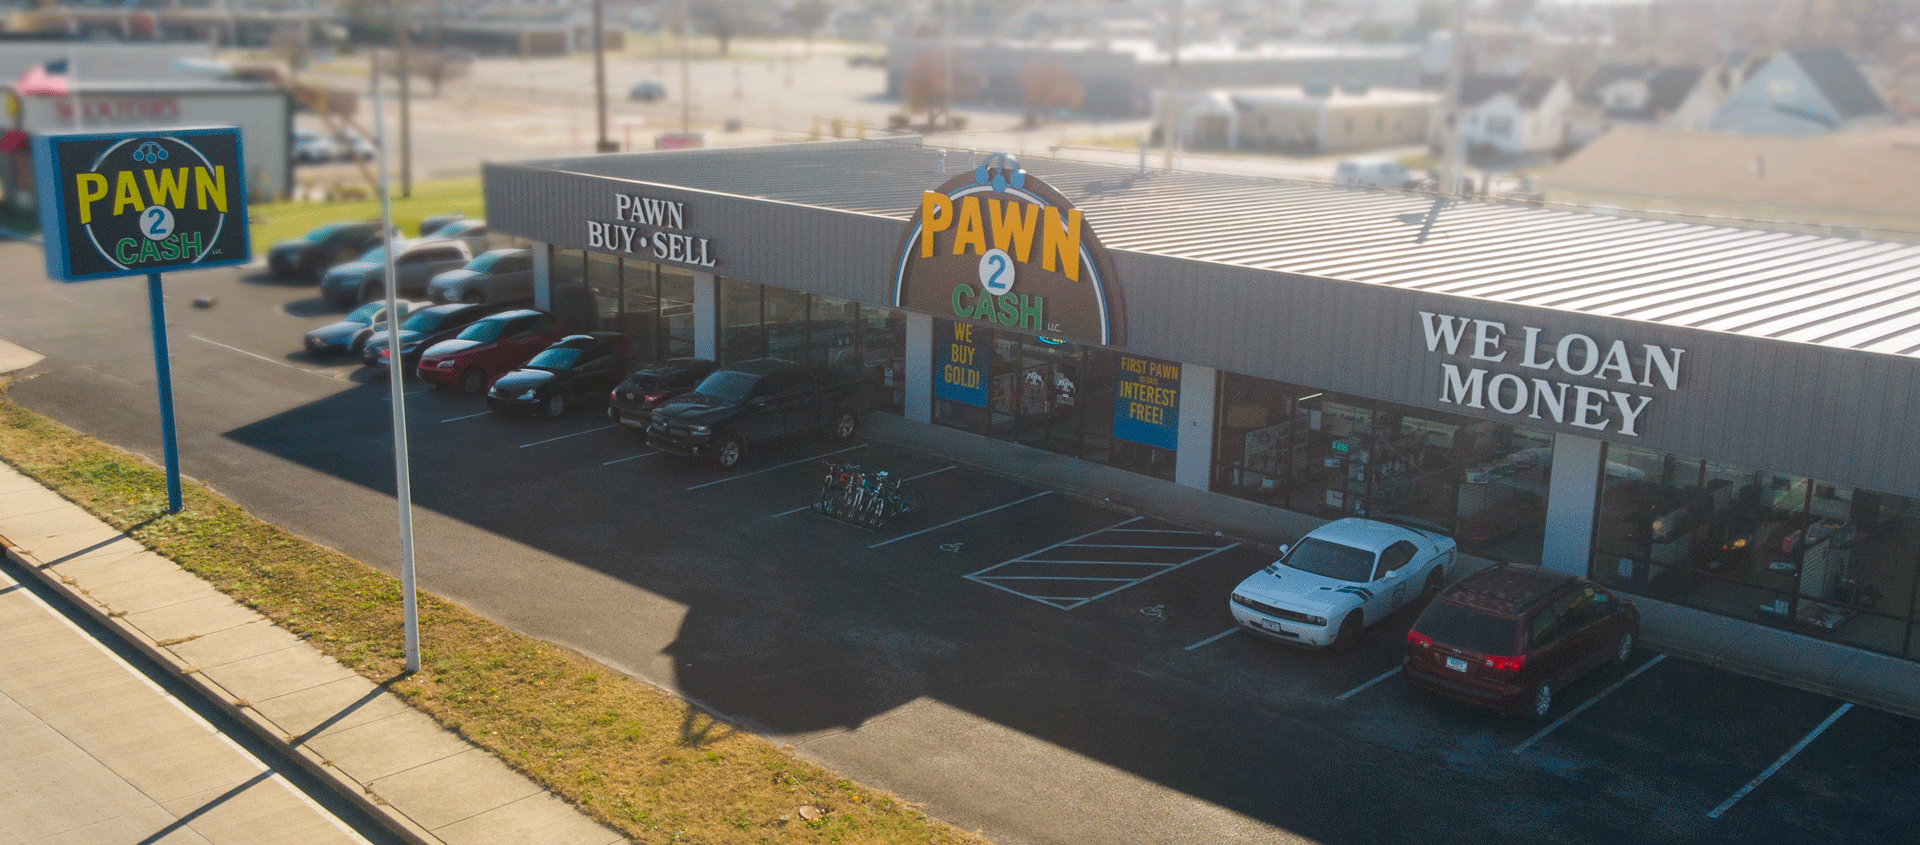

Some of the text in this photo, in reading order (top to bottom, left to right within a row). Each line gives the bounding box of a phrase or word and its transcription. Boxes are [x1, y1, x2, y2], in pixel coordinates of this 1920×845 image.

[76, 165, 228, 225] PAWN
[615, 193, 684, 231] PAWN
[148, 208, 167, 235] 2
[921, 190, 1083, 282] PAWN
[116, 232, 202, 265] CASH
[587, 220, 716, 268] BUY SELL
[988, 254, 1007, 290] 2
[952, 283, 1043, 331] CASH
[954, 321, 973, 343] WE
[951, 343, 975, 366] BUY
[1121, 356, 1178, 380] FIRST PAWN
[1419, 311, 1686, 391] WE LOAN
[944, 364, 980, 390] GOLD!
[1120, 380, 1177, 408] INTEREST
[1129, 401, 1164, 425] FREE!
[1438, 363, 1653, 437] MONEY
